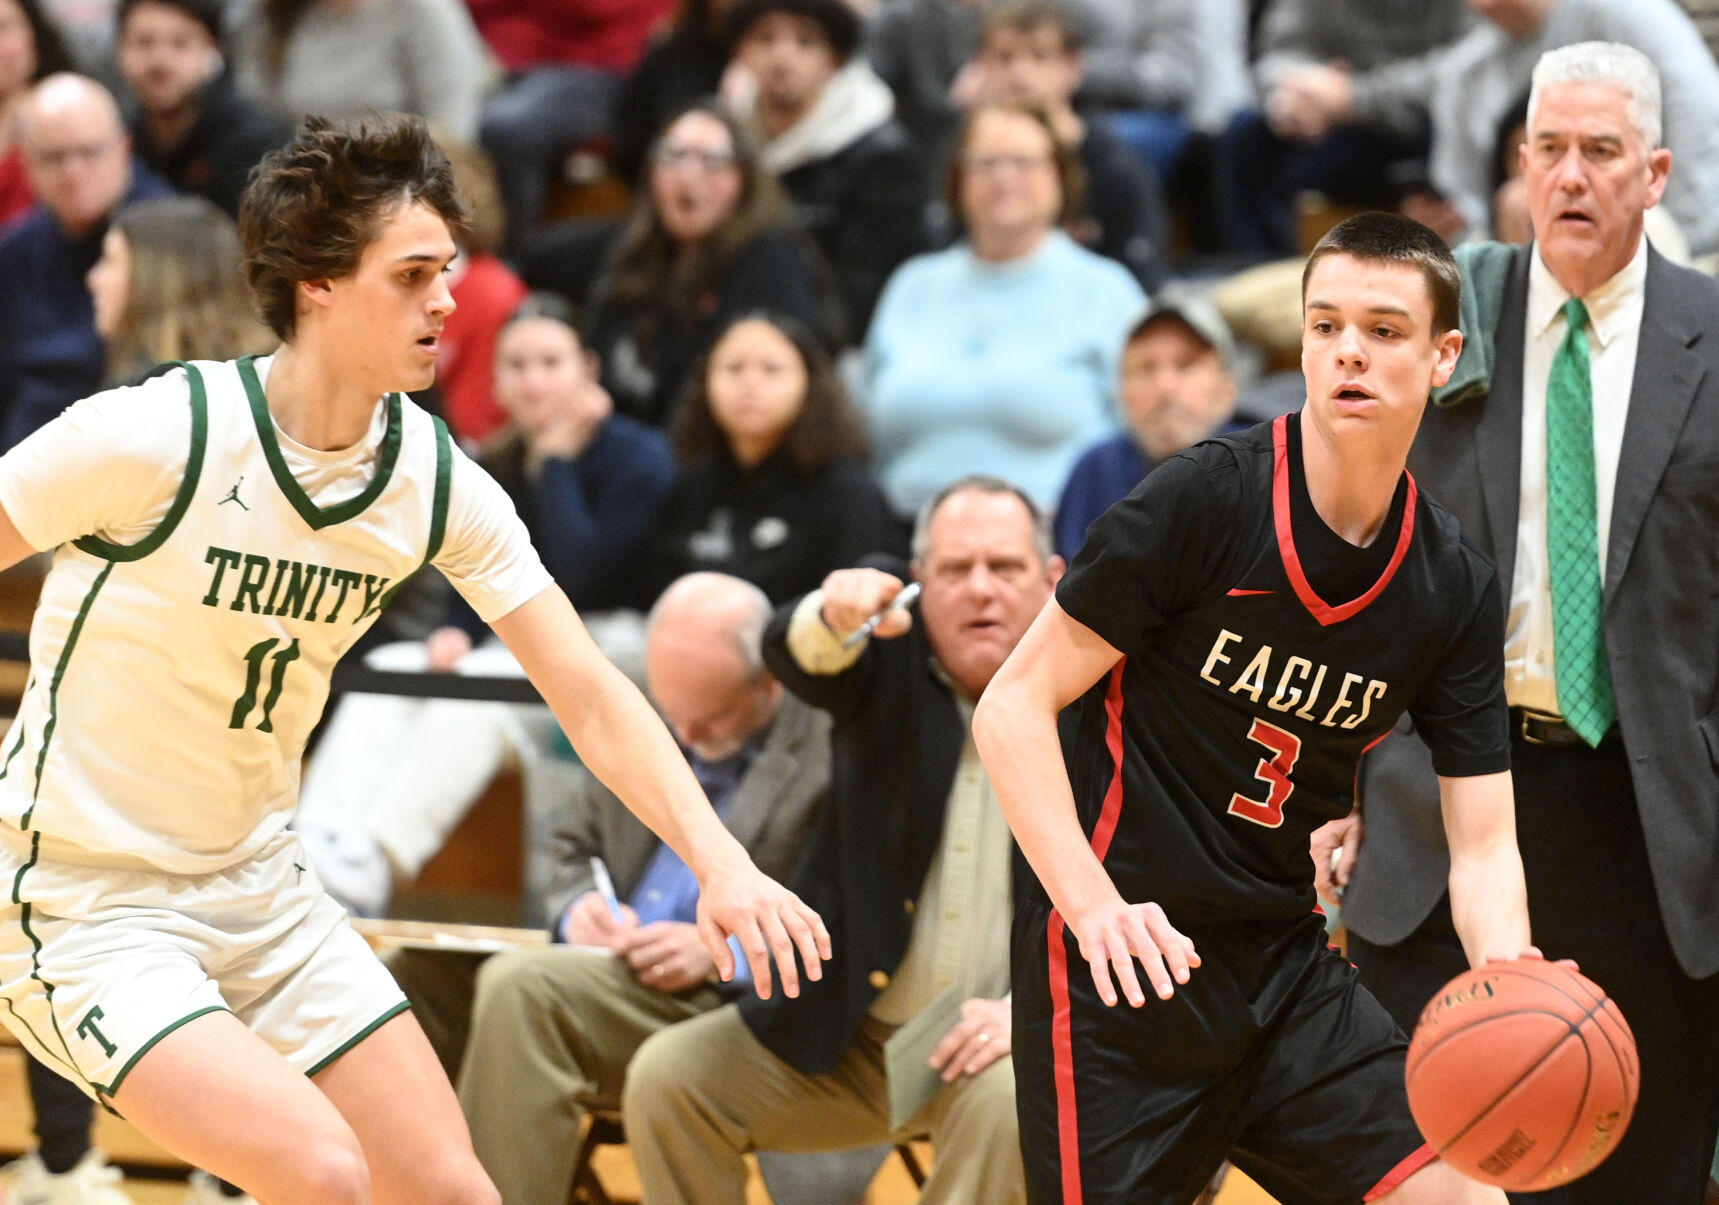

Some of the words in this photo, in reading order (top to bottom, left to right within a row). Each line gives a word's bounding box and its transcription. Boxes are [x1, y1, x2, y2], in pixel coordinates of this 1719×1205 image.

[202, 546, 390, 625] TRINITY
[228, 638, 300, 733] 11
[1200, 629, 1388, 729] EAGLES
[1227, 717, 1301, 828] 3
[76, 1004, 118, 1059] T
